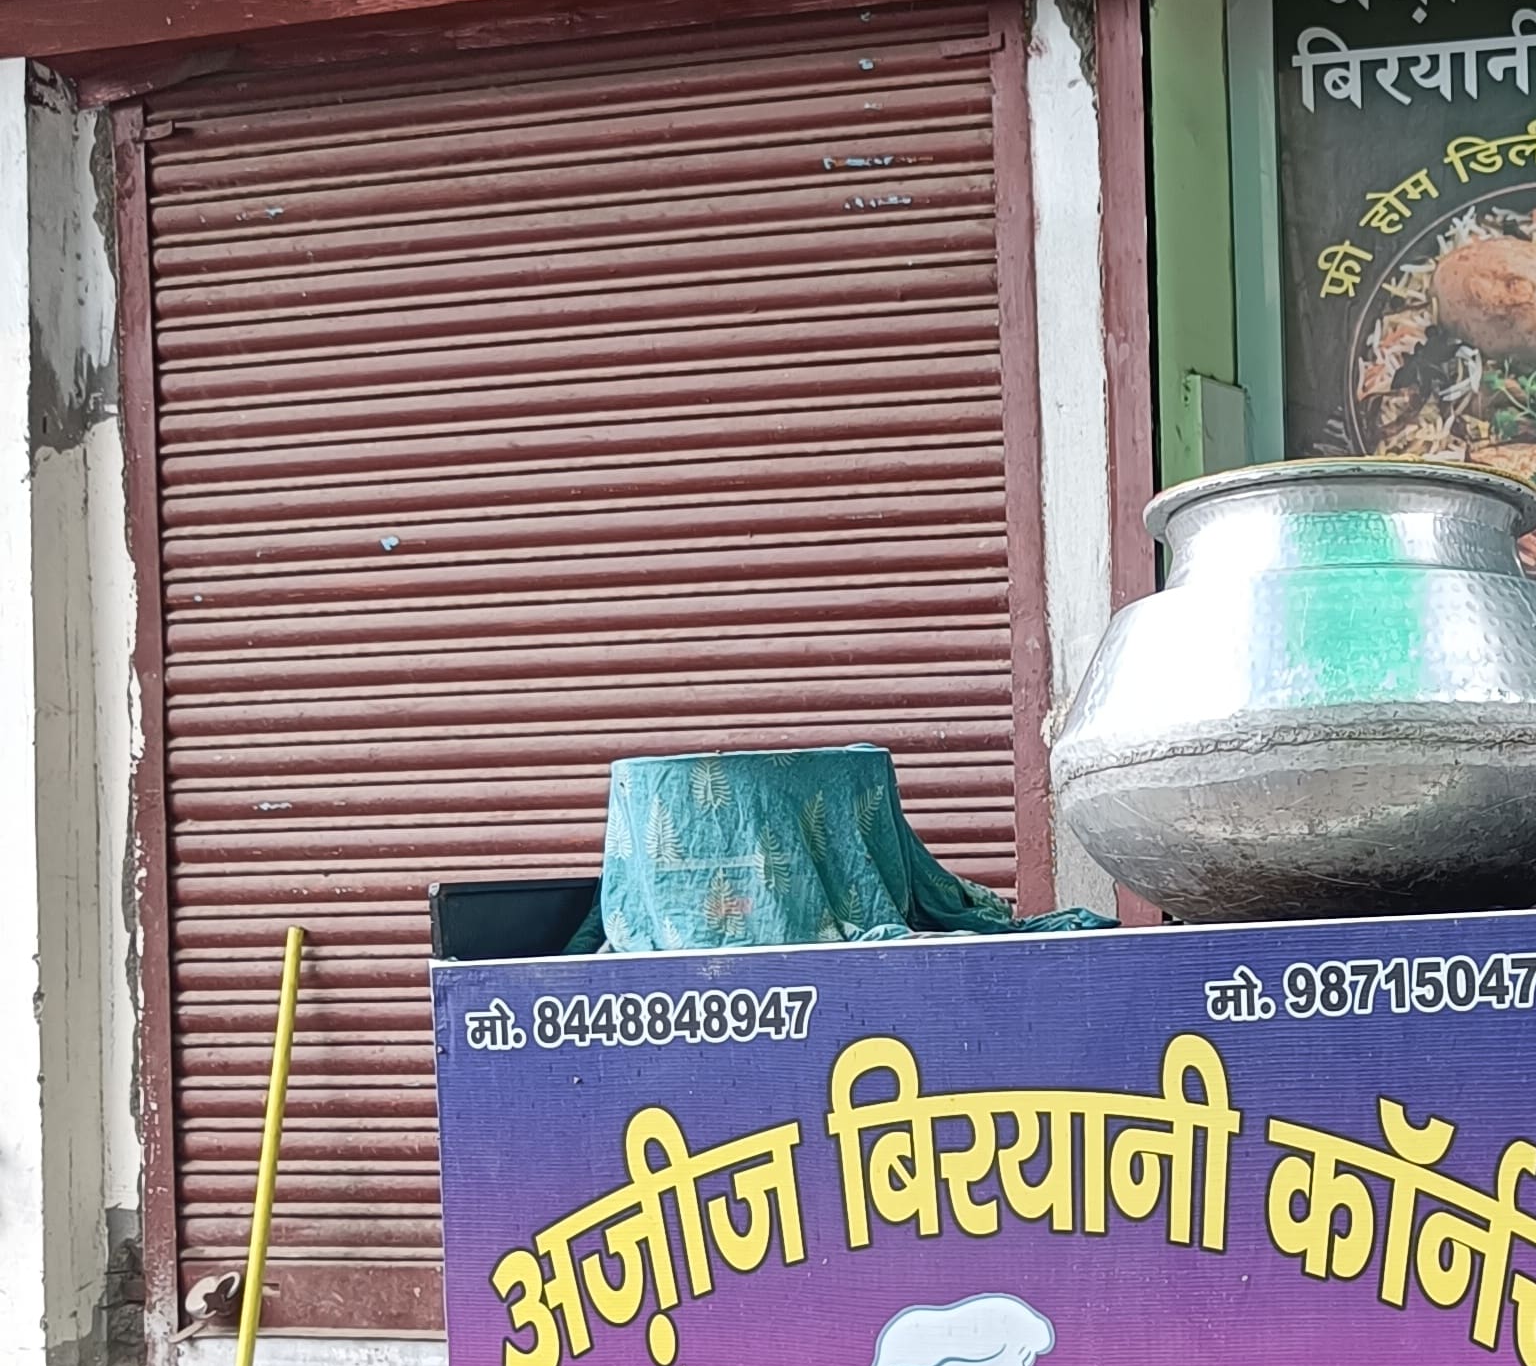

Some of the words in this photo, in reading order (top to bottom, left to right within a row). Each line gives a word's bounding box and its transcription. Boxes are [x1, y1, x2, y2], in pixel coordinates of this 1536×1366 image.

[1317, 239, 1374, 299] फ्री
[1359, 168, 1440, 234] होम
[467, 1001, 526, 1050] मो.
[534, 986, 817, 1047] 8448848947
[1205, 966, 1276, 1021] मो.
[827, 1033, 1242, 1252] बिरयानी
